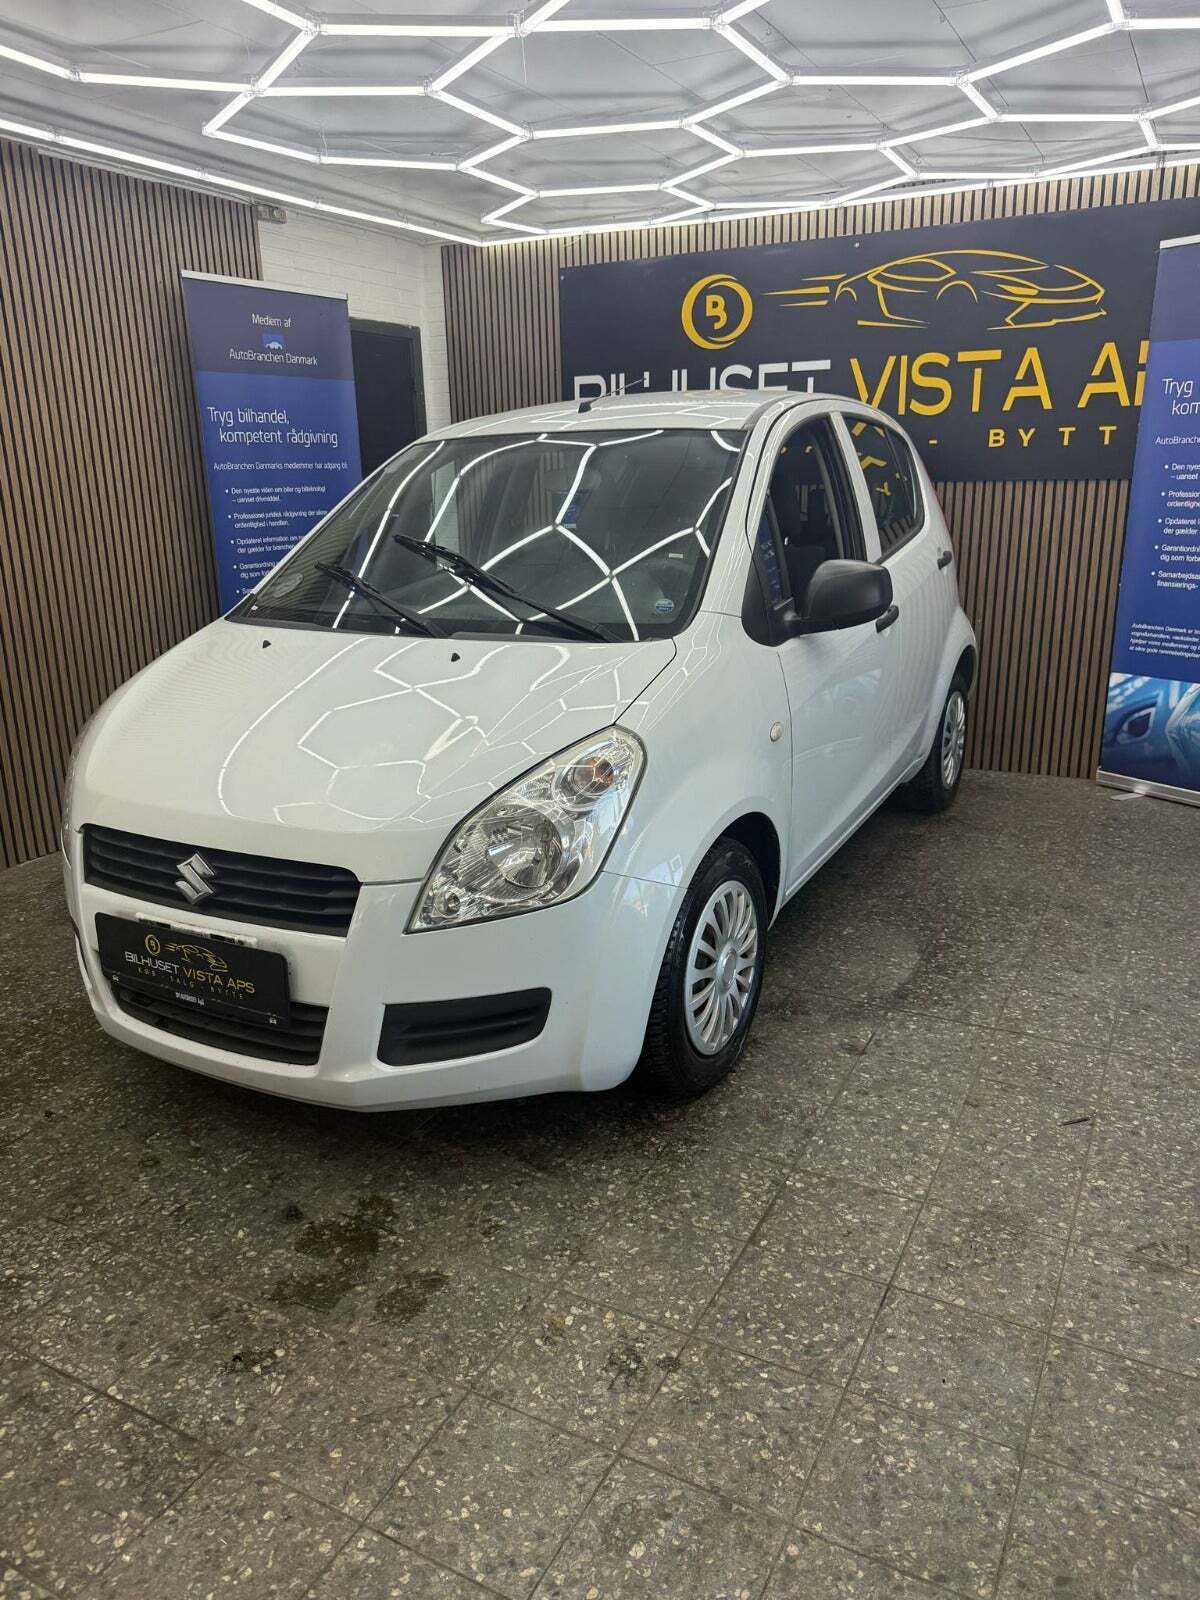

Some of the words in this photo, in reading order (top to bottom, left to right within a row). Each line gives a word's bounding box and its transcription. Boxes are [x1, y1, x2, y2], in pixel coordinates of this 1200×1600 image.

[252, 313, 282, 327] Medlem
[284, 317, 292, 328] af
[229, 348, 284, 363] AutoBranchen
[286, 352, 318, 366] Danmark
[850, 346, 1054, 416] VISTA
[1162, 378, 1194, 398] Tryg
[207, 406, 234, 426] Tryg
[238, 408, 290, 425] bilhandel,
[219, 428, 283, 446] kompetent
[287, 428, 339, 448] rådgivning
[213, 461, 255, 471] AutoBranchen
[1171, 463, 1185, 471] Den
[124, 951, 180, 976] BILHUSET
[182, 966, 223, 987] VISTA
[226, 977, 256, 994] APS
